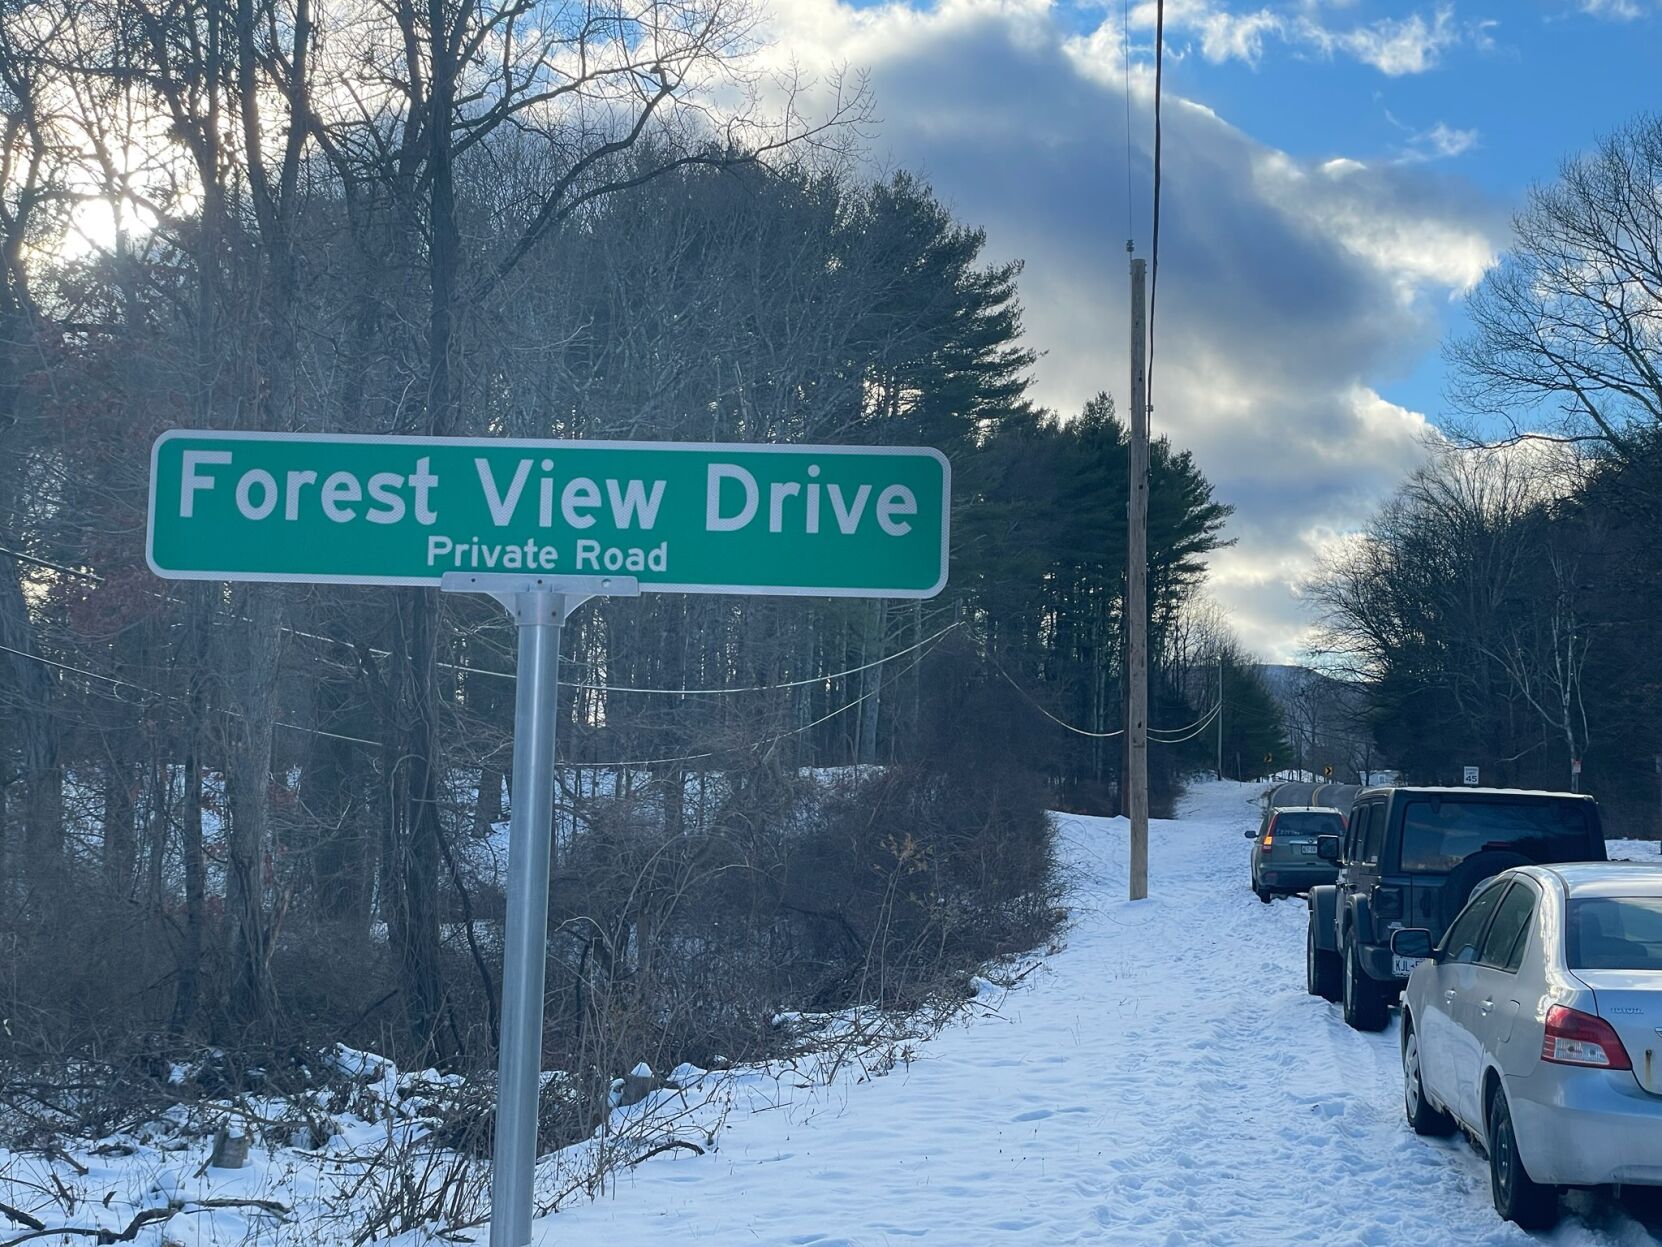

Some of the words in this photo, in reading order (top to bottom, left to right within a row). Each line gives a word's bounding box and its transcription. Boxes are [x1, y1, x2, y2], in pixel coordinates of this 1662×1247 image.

[180, 450, 438, 525] Forest
[474, 458, 667, 529] View
[706, 463, 917, 537] Drive
[427, 536, 558, 569] Private
[576, 539, 668, 572] Road
